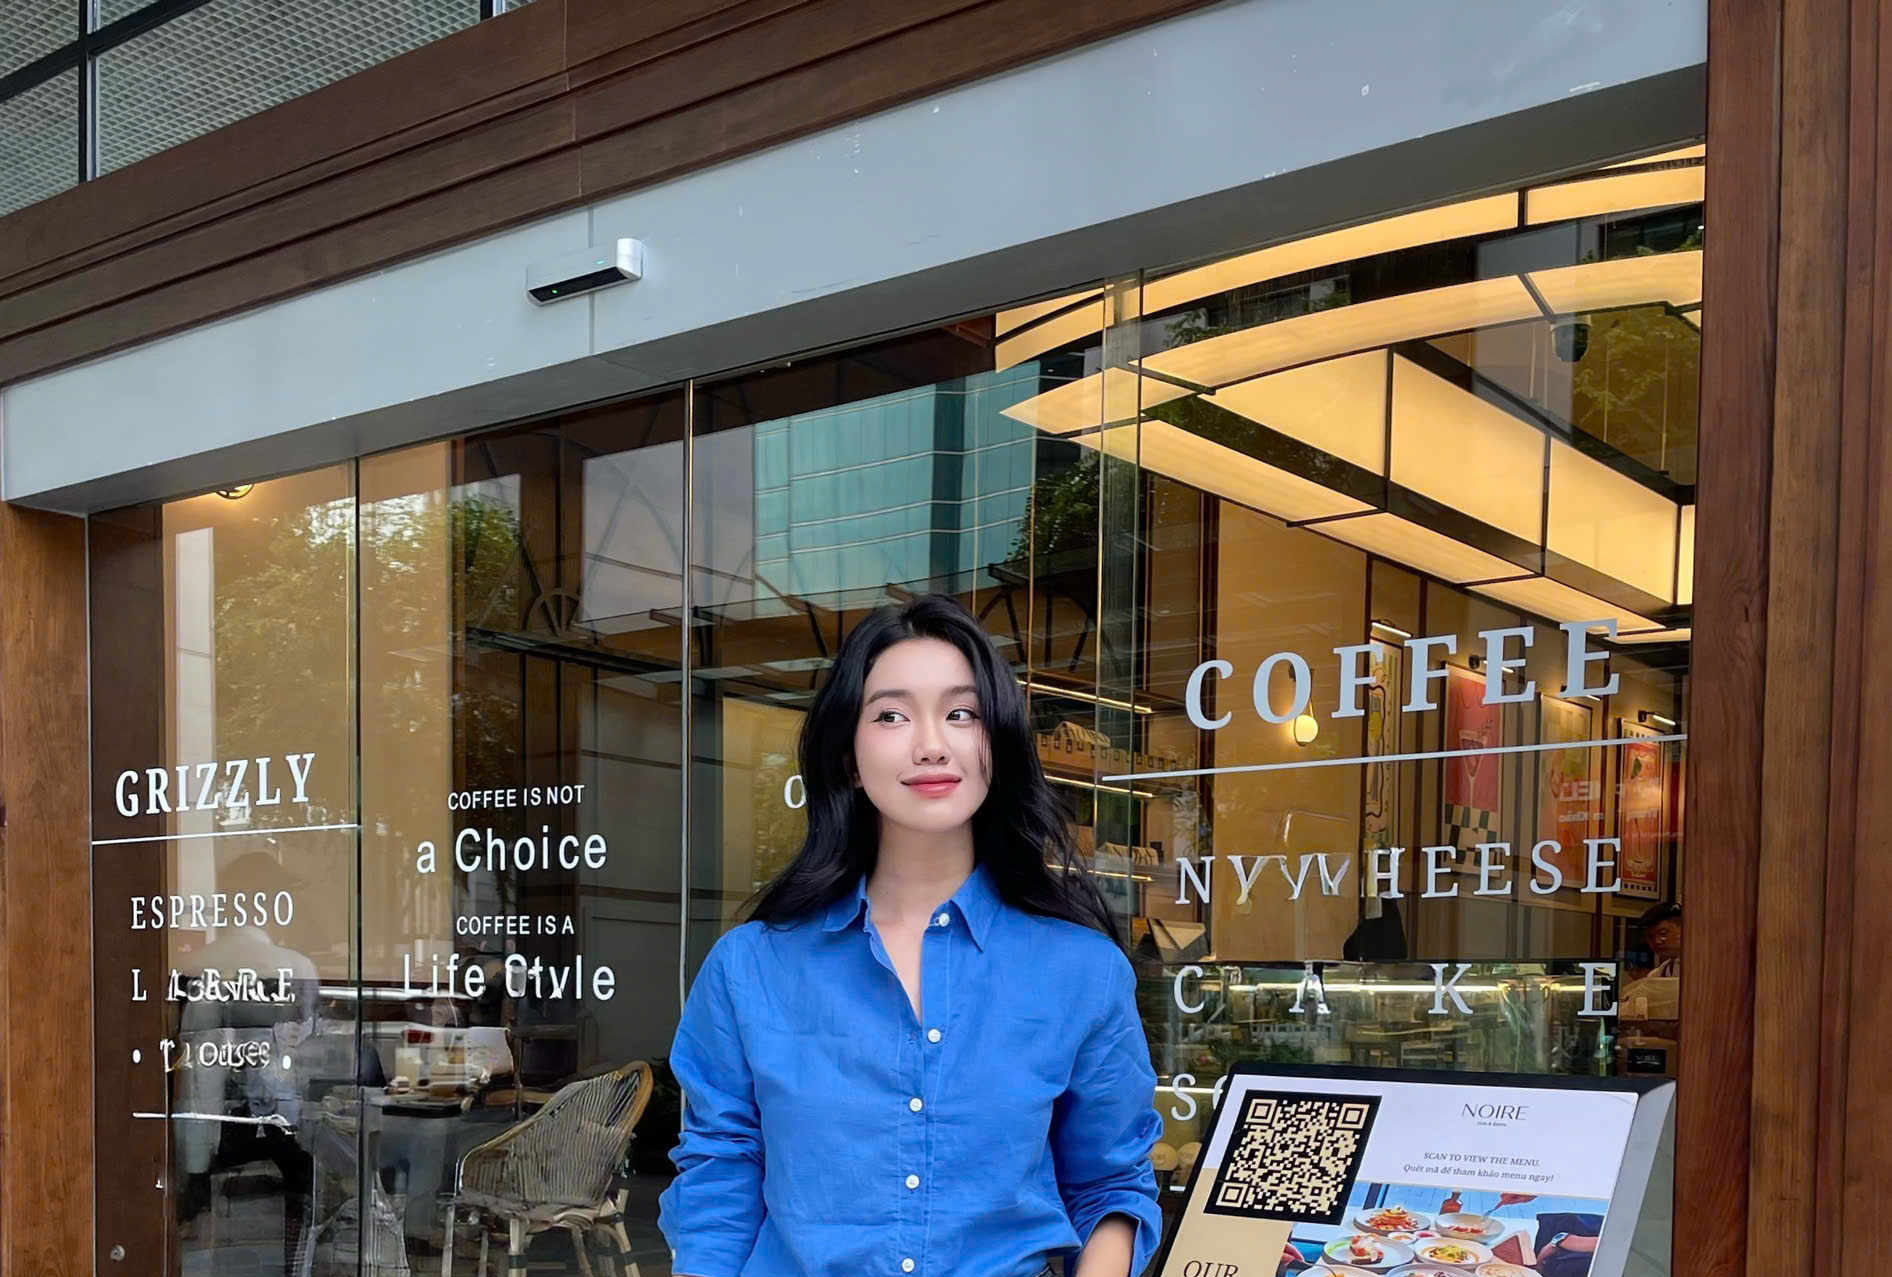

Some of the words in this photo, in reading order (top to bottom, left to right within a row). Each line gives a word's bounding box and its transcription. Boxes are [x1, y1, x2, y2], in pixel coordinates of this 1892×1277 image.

[1185, 617, 1620, 730] COFFEE
[115, 752, 316, 817] GRIZZLY
[447, 788, 517, 811] COFFEE
[523, 787, 542, 807] IS
[546, 784, 585, 805] NOT
[416, 841, 437, 874] a
[455, 825, 608, 873] Choice
[130, 891, 294, 930] ESPRESSO
[456, 916, 530, 935] COFFEE
[537, 915, 557, 935] IS
[561, 915, 575, 935] A
[403, 953, 486, 999] Life
[1461, 1103, 1529, 1121] NOIRE
[1423, 1152, 1447, 1161] SCAN
[1463, 1155, 1489, 1163] VIEW
[1490, 1157, 1508, 1165] THE
[1453, 1167, 1476, 1177] tham
[1501, 1171, 1527, 1180] menu
[1528, 1173, 1554, 1184] ngay!
